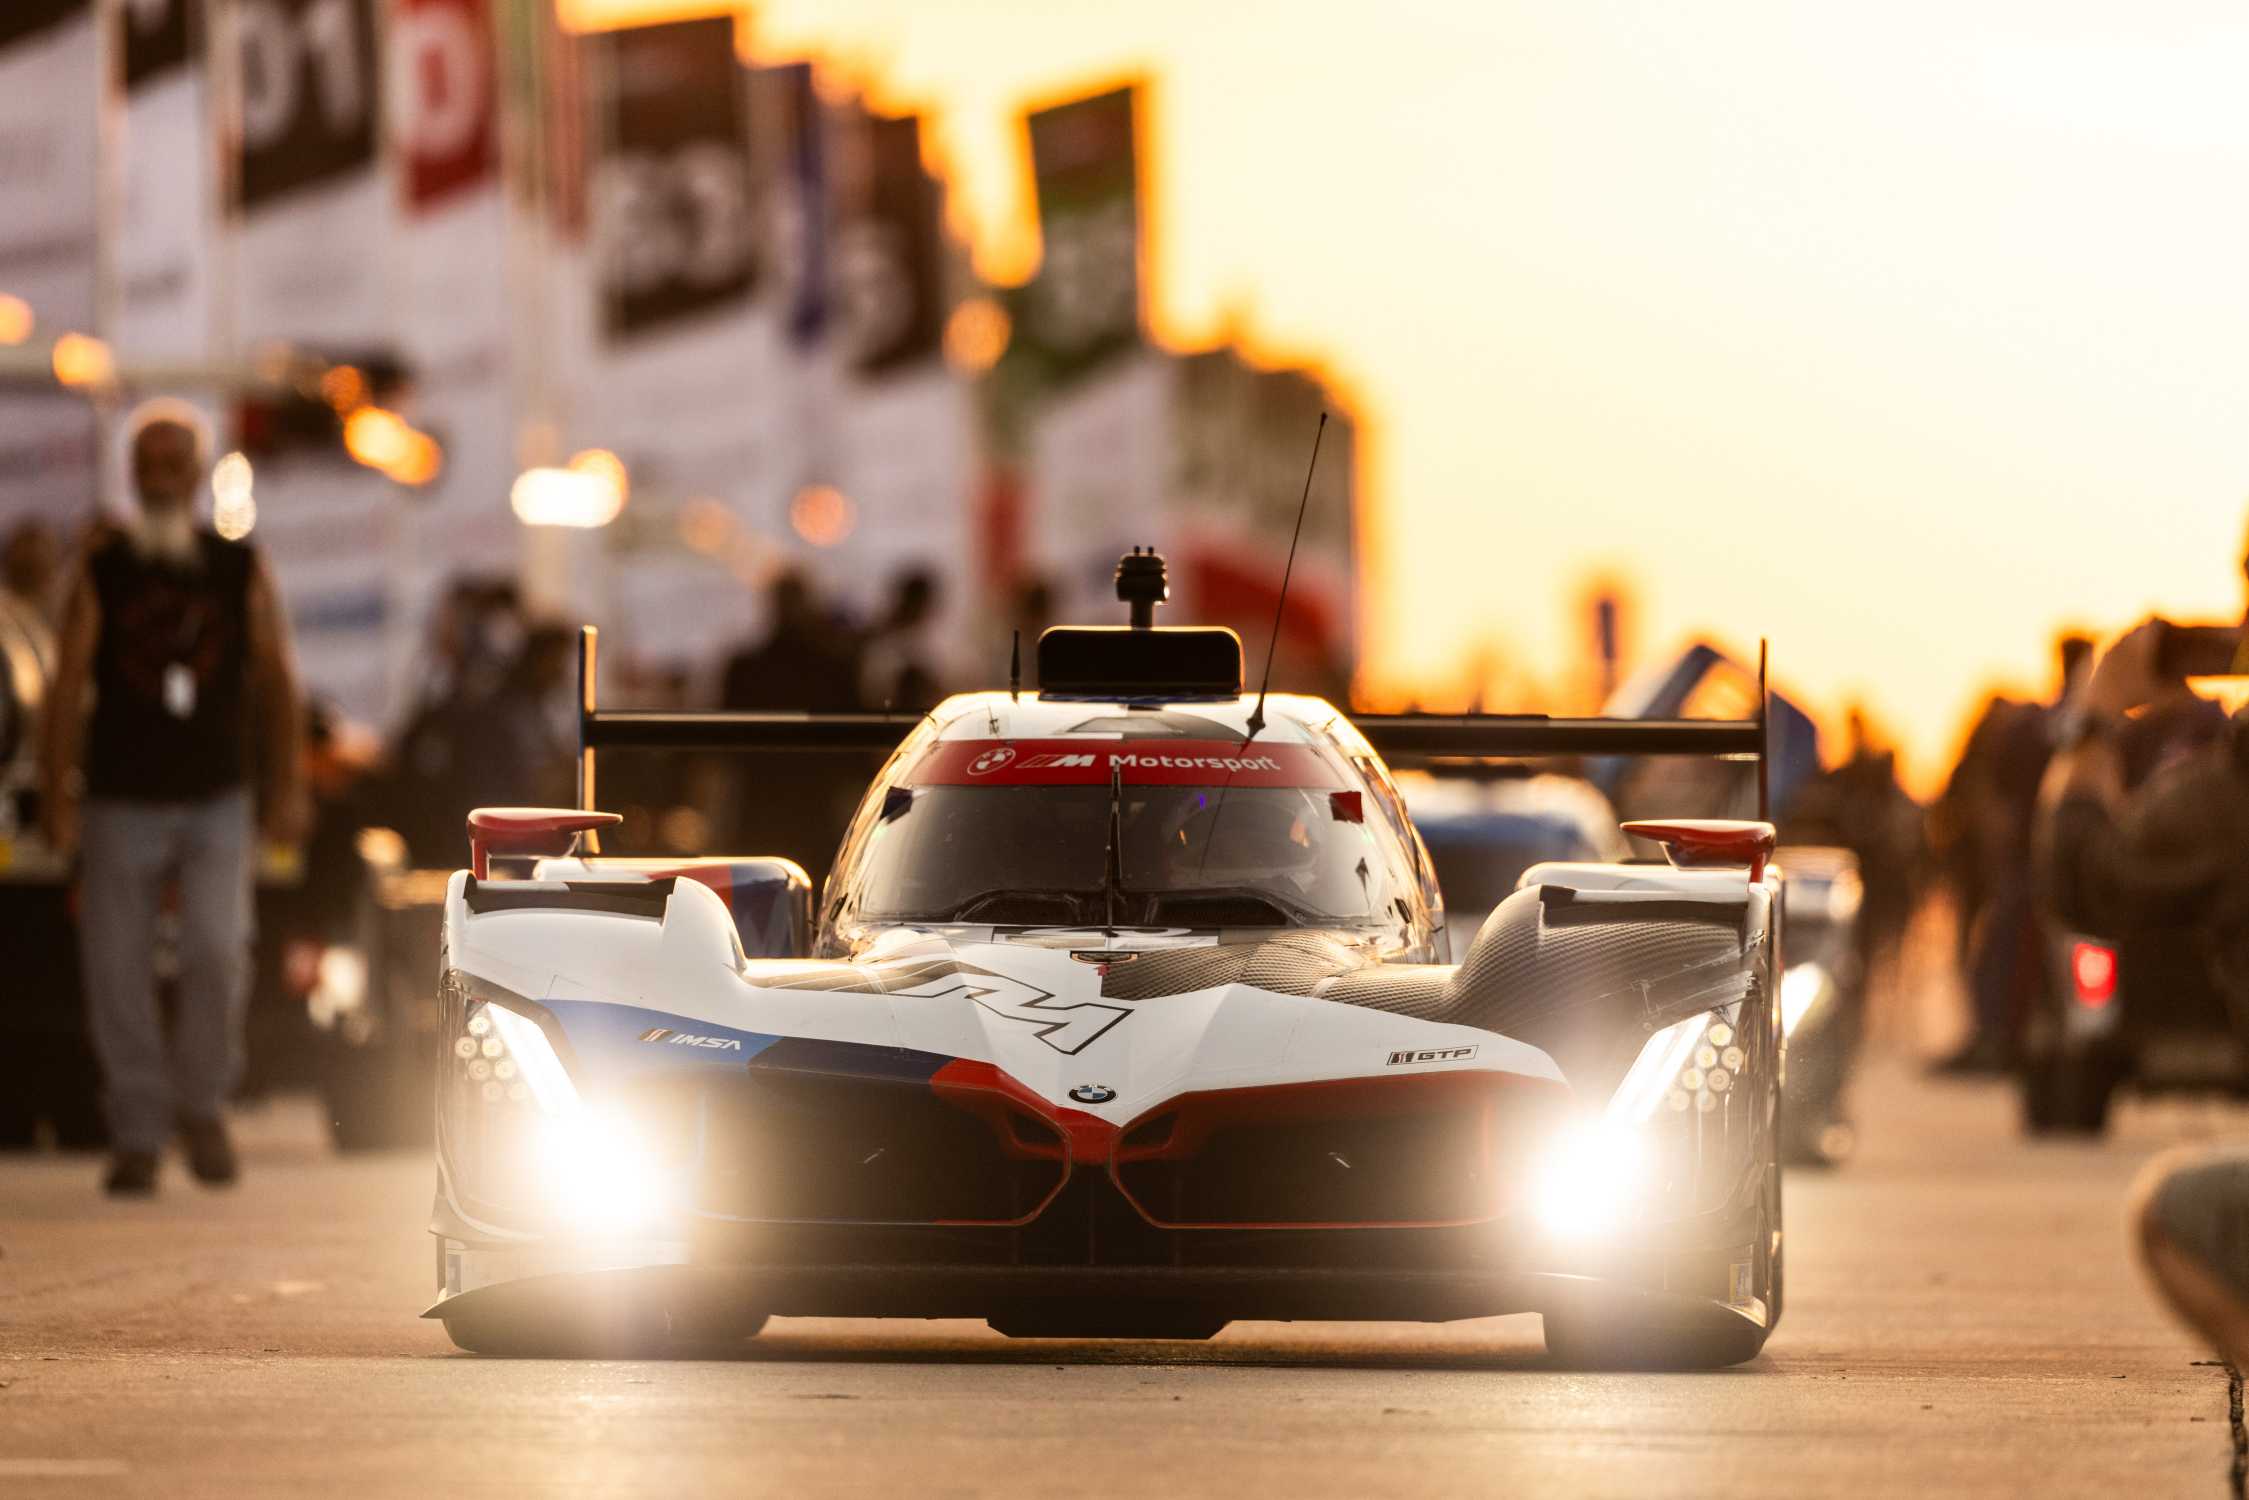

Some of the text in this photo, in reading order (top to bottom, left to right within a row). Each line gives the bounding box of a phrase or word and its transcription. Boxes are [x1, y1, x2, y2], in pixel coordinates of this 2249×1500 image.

[1108, 754, 1281, 771] Motorsport
[669, 1034, 741, 1050] IMSA
[1418, 1048, 1472, 1060] GTP
